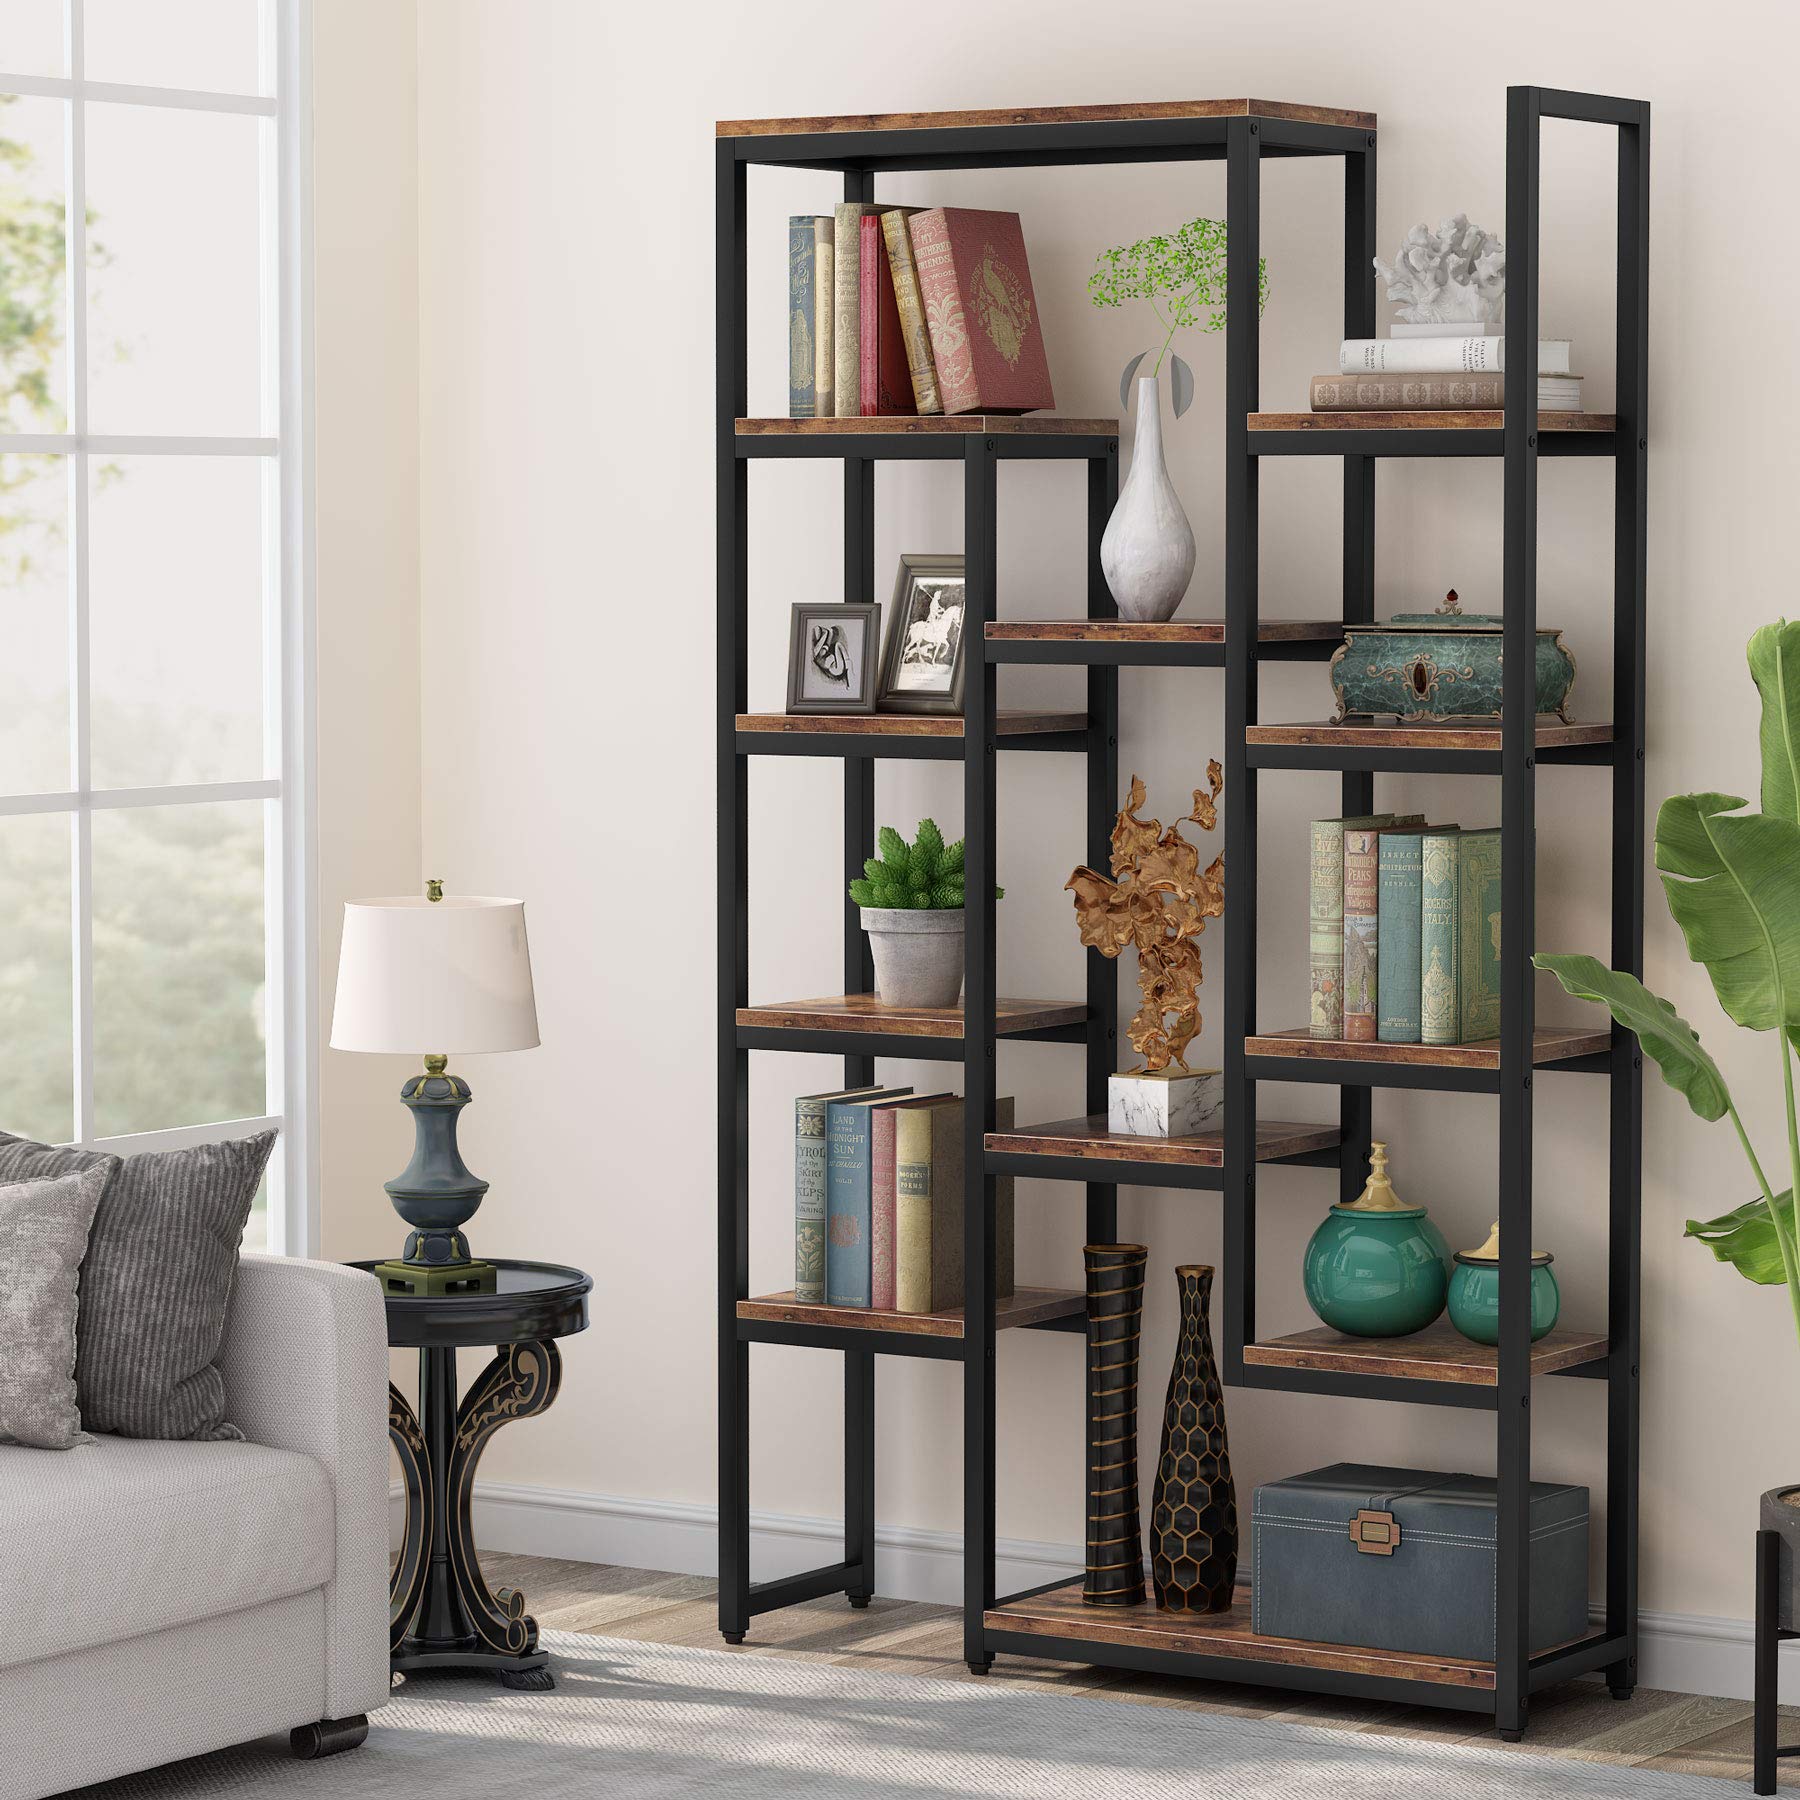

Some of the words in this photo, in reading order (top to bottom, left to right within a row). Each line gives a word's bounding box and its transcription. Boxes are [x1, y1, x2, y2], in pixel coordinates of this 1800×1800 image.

[1382, 851, 1420, 859] INSECT
[1348, 867, 1372, 881] PEAKS
[833, 1114, 855, 1125] LAND
[833, 1143, 855, 1154] SUN
